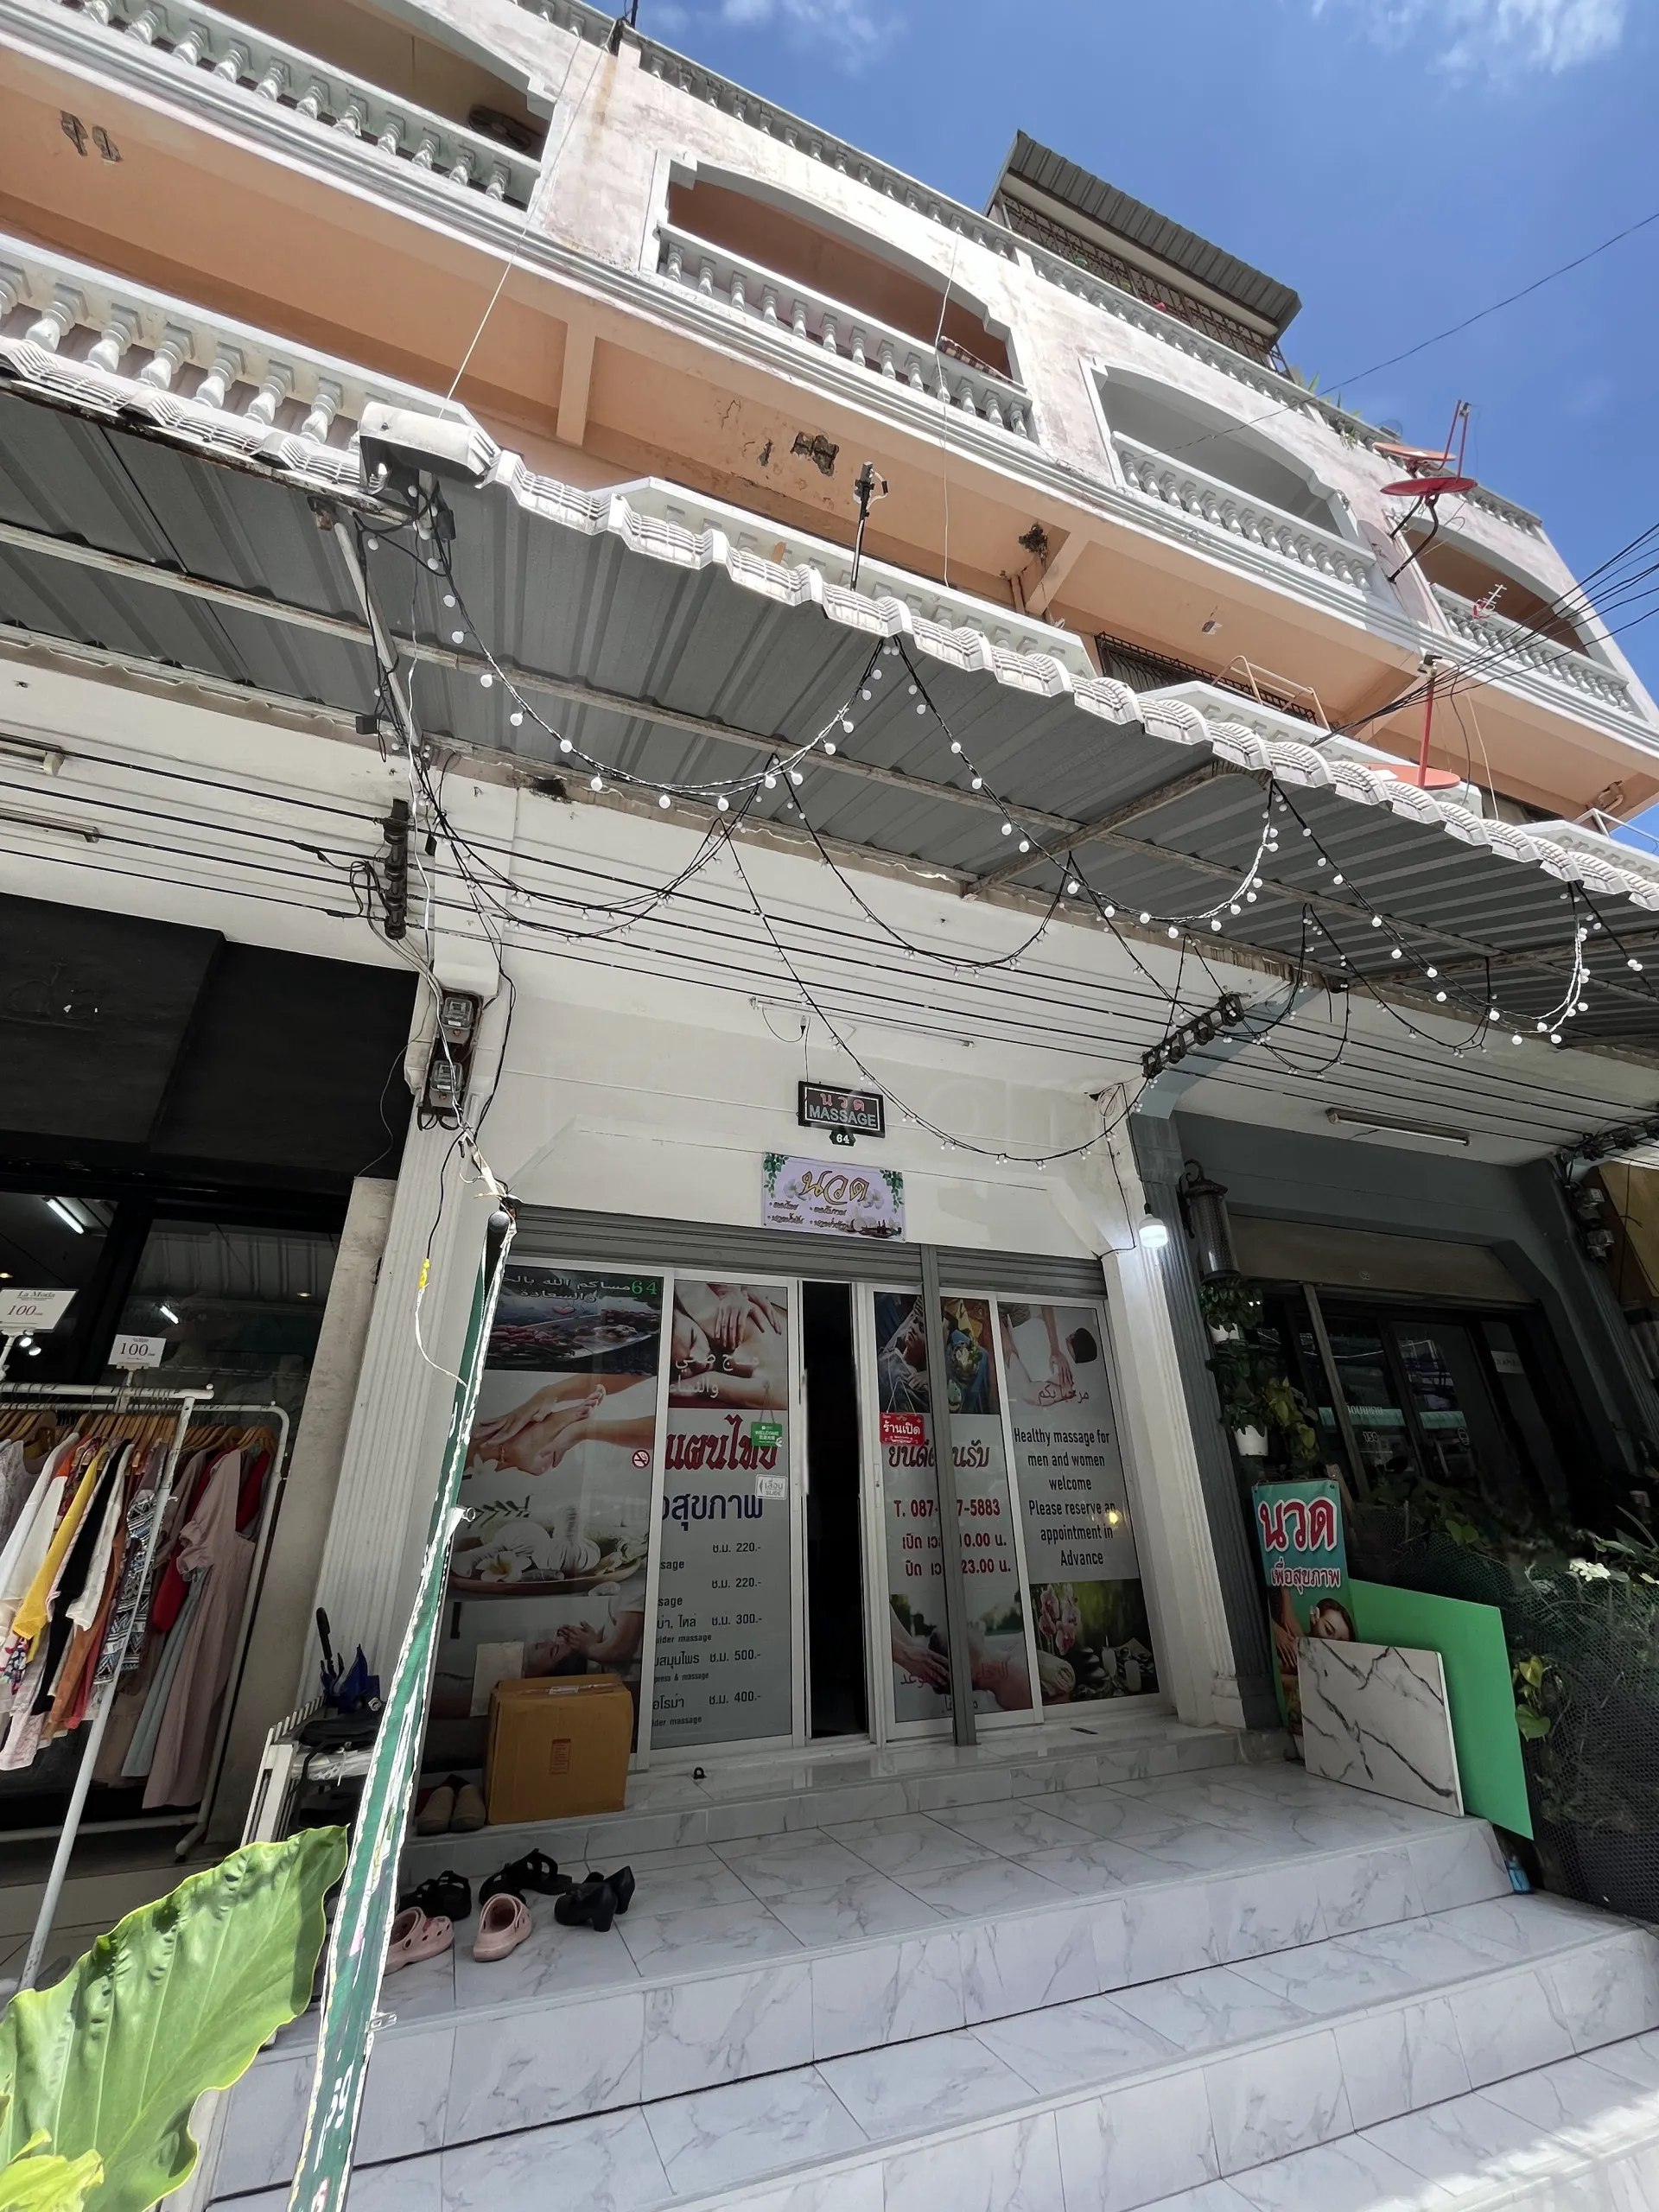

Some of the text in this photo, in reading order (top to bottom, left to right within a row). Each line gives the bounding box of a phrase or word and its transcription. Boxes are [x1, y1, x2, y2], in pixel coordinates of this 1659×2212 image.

[819, 1093, 865, 1112] นวด
[809, 1104, 877, 1128] MASSAGE
[836, 1134, 850, 1144] 64
[798, 1170, 870, 1205] นวด
[630, 1280, 658, 1295] 64
[7, 1305, 37, 1316] 100
[120, 1342, 149, 1357] 100
[882, 1420, 921, 1435] ร้านเปิด
[1014, 1427, 1110, 1446] Healthy massage for
[1027, 1452, 1105, 1466] men and women
[1048, 1475, 1092, 1491] welcome
[893, 1499, 906, 1517] T.
[1028, 1499, 1116, 1516] Please reserve an
[1258, 1497, 1338, 1552] นวด
[902, 1533, 923, 1549] เปิด
[995, 1534, 1007, 1547] น.
[1040, 1523, 1114, 1545] appointment in
[736, 1542, 761, 1553] 220.-
[1060, 1549, 1104, 1567] Advance
[906, 1560, 922, 1577] ปิด
[962, 1559, 995, 1574] 23.00
[1000, 1560, 1011, 1573] น.
[1271, 1556, 1341, 1595] เพื่อสุขภาพ
[736, 1578, 761, 1588] 220.-
[736, 1614, 763, 1624] 300.-
[678, 1634, 712, 1643] massage
[734, 1649, 761, 1660] 500.-
[682, 1672, 709, 1681] massage
[734, 1691, 761, 1702] 400.-
[669, 1716, 702, 1726] massage
